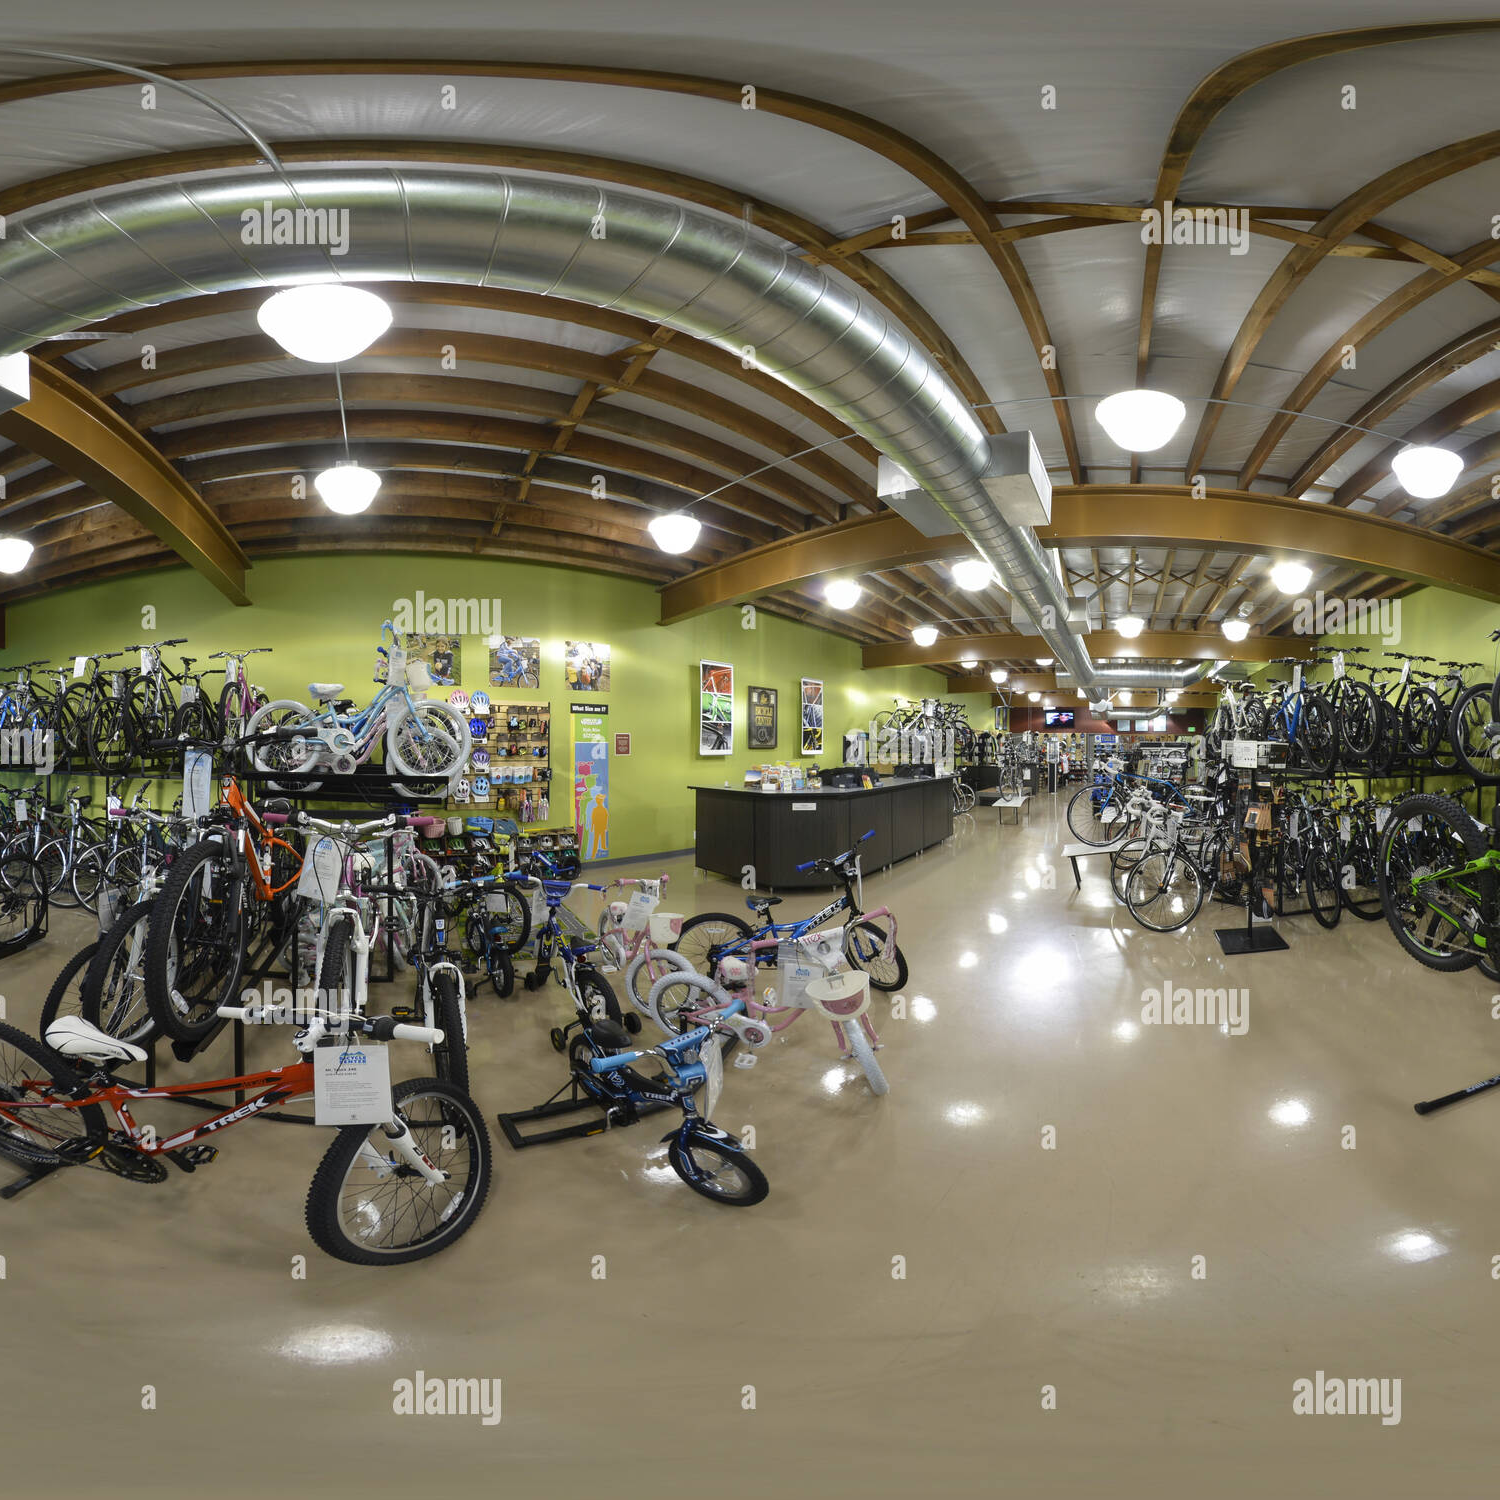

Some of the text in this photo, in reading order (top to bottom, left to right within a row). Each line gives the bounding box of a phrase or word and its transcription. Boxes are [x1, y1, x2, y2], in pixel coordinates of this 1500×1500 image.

[803, 898, 844, 933] TREK
[644, 1088, 678, 1102] TREK
[203, 1095, 270, 1131] TREK
